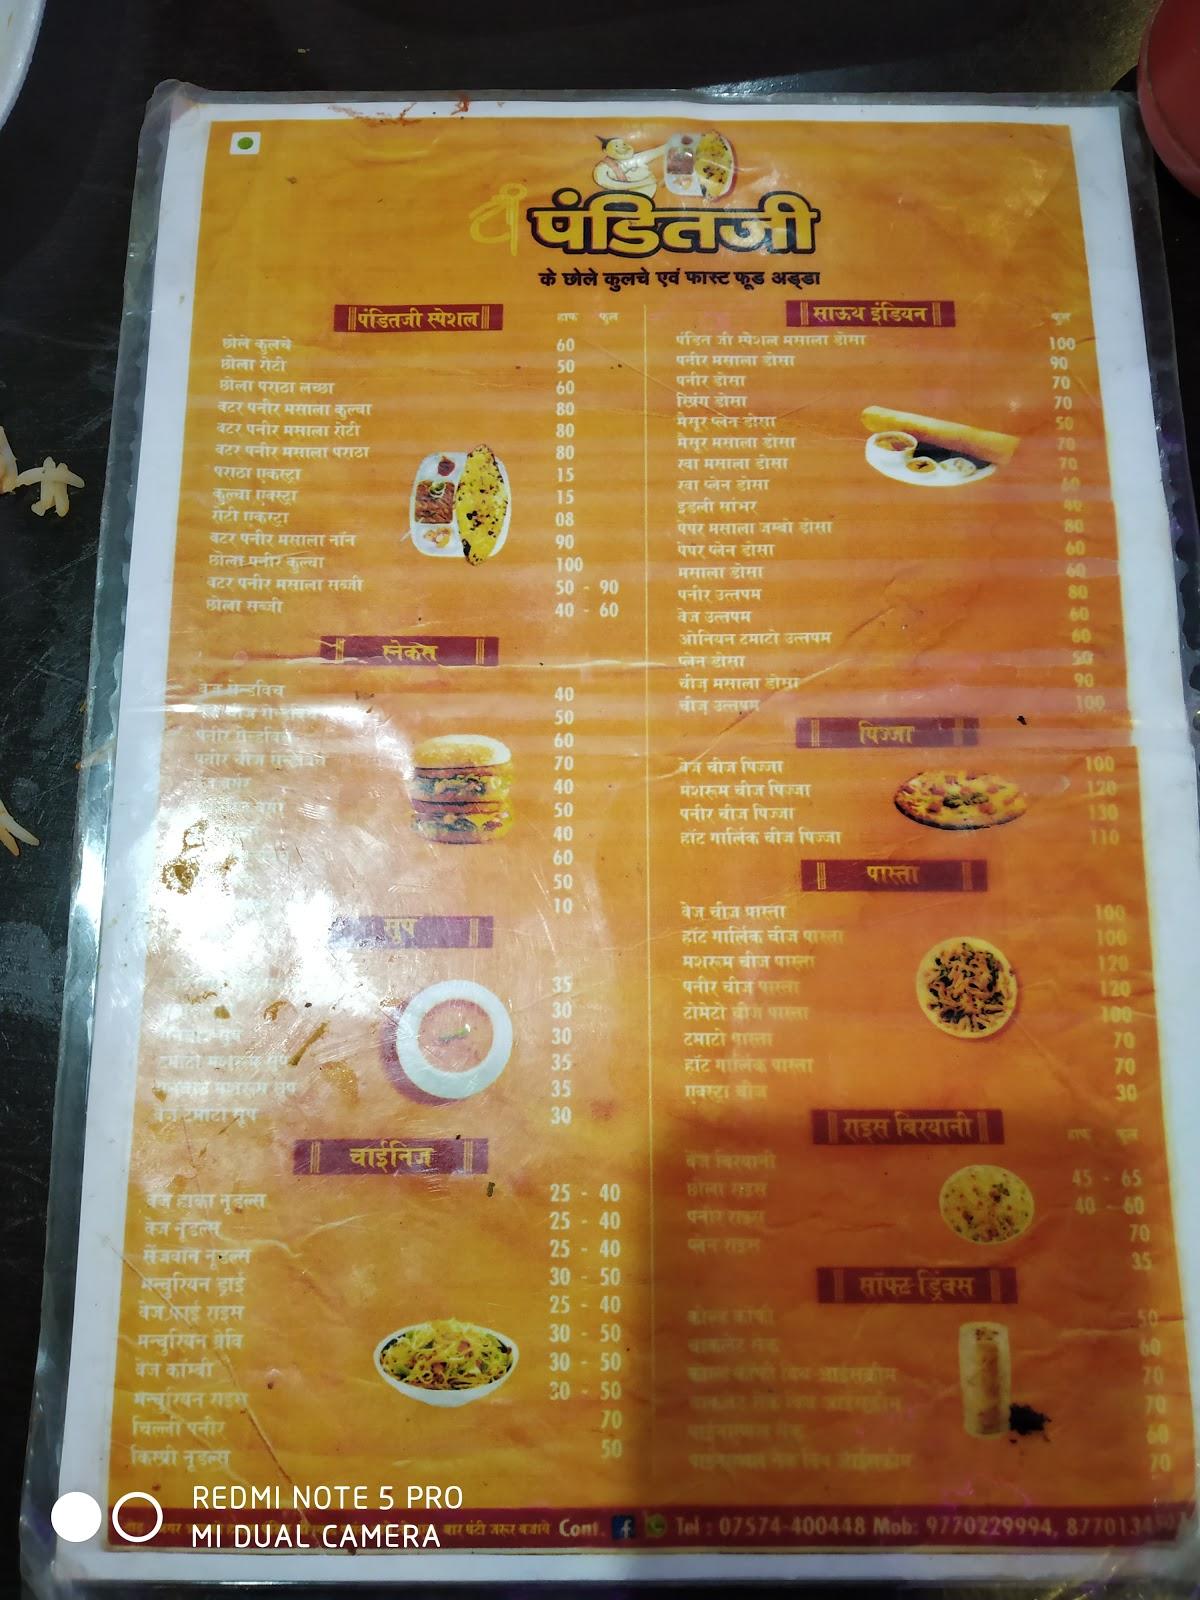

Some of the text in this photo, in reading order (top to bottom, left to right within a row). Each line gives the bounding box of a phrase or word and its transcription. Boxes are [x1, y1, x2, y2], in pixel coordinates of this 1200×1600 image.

[527, 187, 821, 258] पंडितजी
[538, 268, 556, 287] के
[562, 267, 598, 287] छोले
[604, 266, 650, 292] कुलचे
[658, 268, 681, 287] एवं
[686, 271, 730, 287] फास्ट
[735, 271, 765, 290] फूड
[357, 308, 480, 330] पंडितजी स्पेशल
[813, 302, 929, 325] साऊथ इंडियन
[556, 338, 575, 352] 60
[738, 331, 866, 346] स्पेशल मसाला डोसा
[1050, 337, 1076, 351] 100
[557, 360, 575, 374] 50
[676, 352, 759, 367] पनीर मसाला
[1050, 356, 1068, 370] 90
[676, 372, 746, 387] पनीर डोसा
[1052, 376, 1071, 390] 70
[258, 382, 296, 394] पराठा
[556, 381, 575, 395] 60
[248, 398, 331, 417] पनीर मसाला
[714, 392, 748, 408] डोसा
[1055, 396, 1073, 410] 70
[556, 402, 575, 416] 80
[247, 419, 330, 438] पनीर मसाला
[556, 424, 575, 438] 80
[1056, 416, 1074, 430] 50
[712, 434, 797, 449] मसाला डोसा
[245, 442, 370, 461] पनीर मसाला पराठा
[556, 446, 575, 460] 80
[704, 454, 789, 470] मसाला डोसा
[213, 466, 252, 480] पराठा
[557, 468, 575, 482] 15
[736, 476, 770, 491] डोसा
[557, 490, 575, 504] 15
[555, 512, 574, 527] 08
[709, 518, 833, 535] मसाला डोसा
[240, 529, 326, 548] पनीर मसाला
[555, 535, 575, 549] 90
[741, 541, 776, 557] डोसा
[556, 557, 584, 572] 100
[678, 563, 764, 579] मसाला डोसा
[238, 574, 324, 591] पनीर मसाला
[556, 580, 620, 595] 50 90
[677, 585, 763, 602] पनीर उत्तपम
[555, 603, 620, 617] 40 60
[704, 611, 752, 623] उत्तपम
[740, 629, 833, 645] टमाटो उत्तपम
[711, 651, 746, 668] डोसा
[713, 677, 761, 690] मसाला
[1074, 673, 1095, 688] 90
[554, 687, 574, 702] 40
[554, 709, 574, 725] 50
[859, 720, 915, 744] पिज्जा
[554, 733, 574, 748] 60
[554, 756, 574, 771] 70
[740, 756, 785, 774] पिज्जा
[554, 779, 574, 794] 40
[768, 780, 812, 798] पिज्जा
[554, 802, 574, 818] 50
[680, 803, 796, 824] पनीर पिज्जा
[554, 825, 574, 841] 40
[798, 827, 843, 845] पिज्जा
[554, 849, 574, 865] 60
[554, 874, 574, 890] 50
[866, 865, 921, 884] पास्ता
[554, 898, 574, 914] 10
[681, 901, 705, 919] वेज
[745, 905, 787, 919] पास्ता
[552, 976, 572, 993] 35
[682, 977, 718, 996] पनीर
[552, 1002, 572, 1018] 30
[552, 1028, 572, 1044] 30
[1113, 1031, 1135, 1048] 70
[552, 1054, 572, 1071] 35
[1114, 1057, 1136, 1075] 70
[552, 1080, 572, 1097] 35
[551, 1107, 572, 1124] 30
[843, 1111, 973, 1141] राइस बिरयानी
[1129, 1225, 1150, 1242] 70
[550, 1267, 621, 1286] 30 50
[860, 1272, 913, 1295] सॉफ्ट
[550, 1296, 621, 1314] 25 40
[550, 1324, 621, 1342] 30 50
[550, 1352, 621, 1371] 30 50
[599, 1381, 621, 1400] 50
[718, 1515, 866, 1537] 07574-400448
